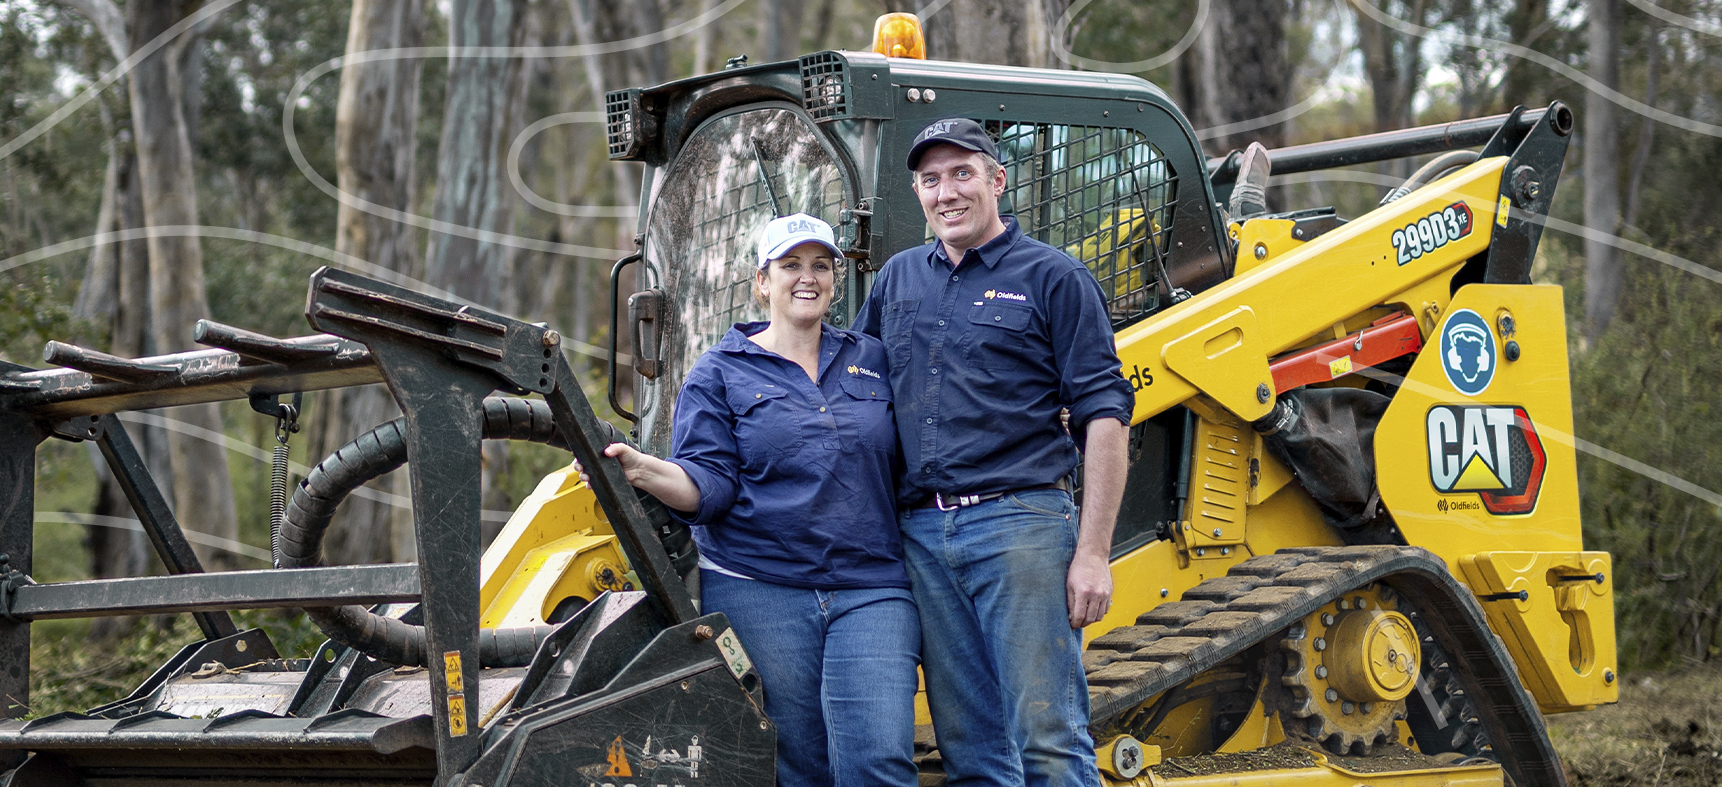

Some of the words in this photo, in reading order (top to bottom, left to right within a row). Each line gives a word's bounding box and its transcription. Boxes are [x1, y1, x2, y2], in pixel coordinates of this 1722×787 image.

[924, 121, 954, 140] CAT
[787, 219, 817, 234] CAT
[1392, 207, 1461, 266] 299D3
[1457, 212, 1468, 226] XE
[996, 291, 1027, 302] Oldfields
[1427, 406, 1515, 491] CAT
[1450, 500, 1480, 511] Oldfields
